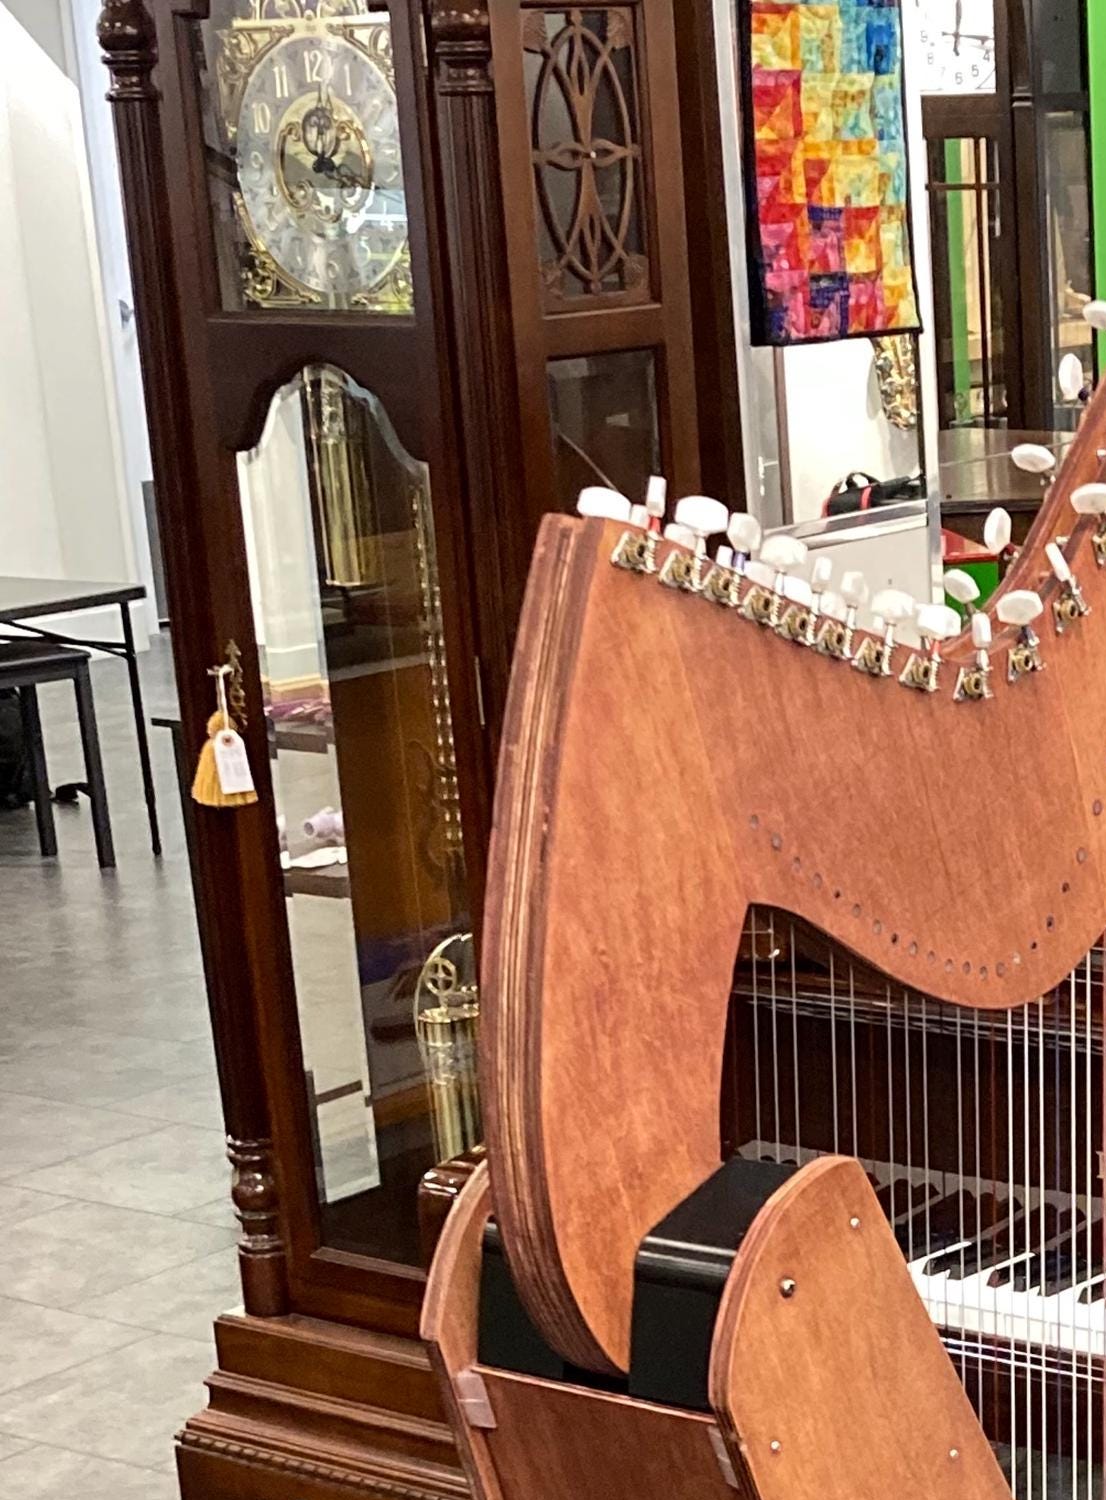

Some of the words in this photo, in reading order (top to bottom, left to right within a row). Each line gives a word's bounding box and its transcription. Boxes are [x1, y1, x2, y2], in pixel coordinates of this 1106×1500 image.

[304, 50, 322, 83] 12
[982, 48, 991, 62] 4
[273, 65, 289, 98] 11
[344, 63, 352, 96] 1
[954, 71, 963, 85] 6
[971, 64, 980, 78] 5
[252, 102, 271, 133] 10
[251, 151, 264, 181] 9
[380, 200, 394, 231] 4
[360, 235, 372, 268] 5
